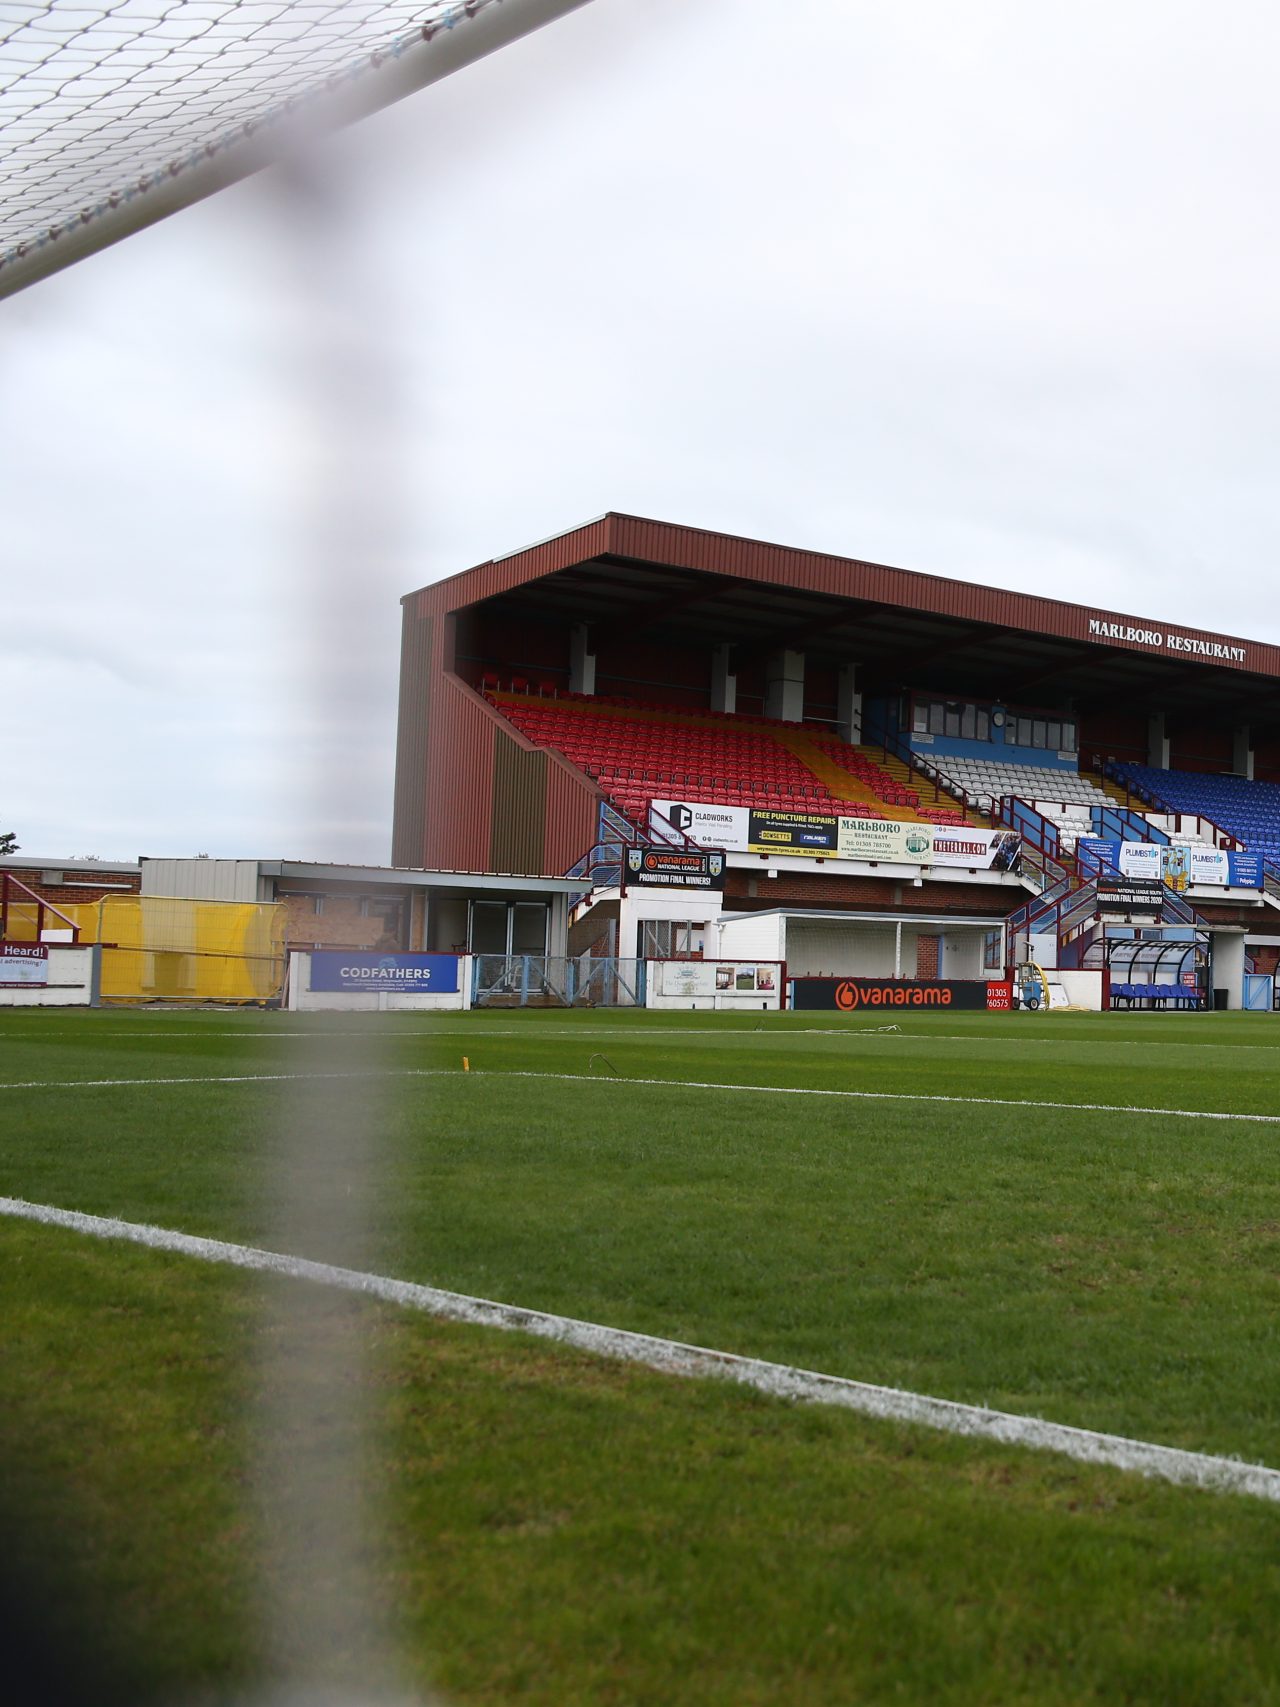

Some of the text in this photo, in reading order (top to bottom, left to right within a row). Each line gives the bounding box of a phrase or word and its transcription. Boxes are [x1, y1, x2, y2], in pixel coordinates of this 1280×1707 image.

[1089, 619, 1246, 662] MARLBORO RESTAURANT
[695, 812, 733, 823] CLADWORKS
[752, 811, 836, 825] FREE PUNCTURE REPAIRS
[841, 820, 901, 833] MARLBORO
[762, 831, 790, 840] DOWSETTS
[856, 840, 872, 848] 01305
[934, 840, 986, 854] THETERRAS.COM
[657, 855, 700, 865] vanarama
[639, 873, 711, 886] PROMOTION FINAL WINNERS!
[1096, 893, 1120, 902] PROMOTION
[1120, 894, 1132, 903] FINAL
[1132, 895, 1150, 904] WINNERS
[4, 945, 44, 957] Heard!
[4, 959, 43, 967] advertising?
[340, 967, 431, 979] CODFATHERS
[859, 987, 952, 1005] vanarama
[987, 988, 1007, 997] 01305
